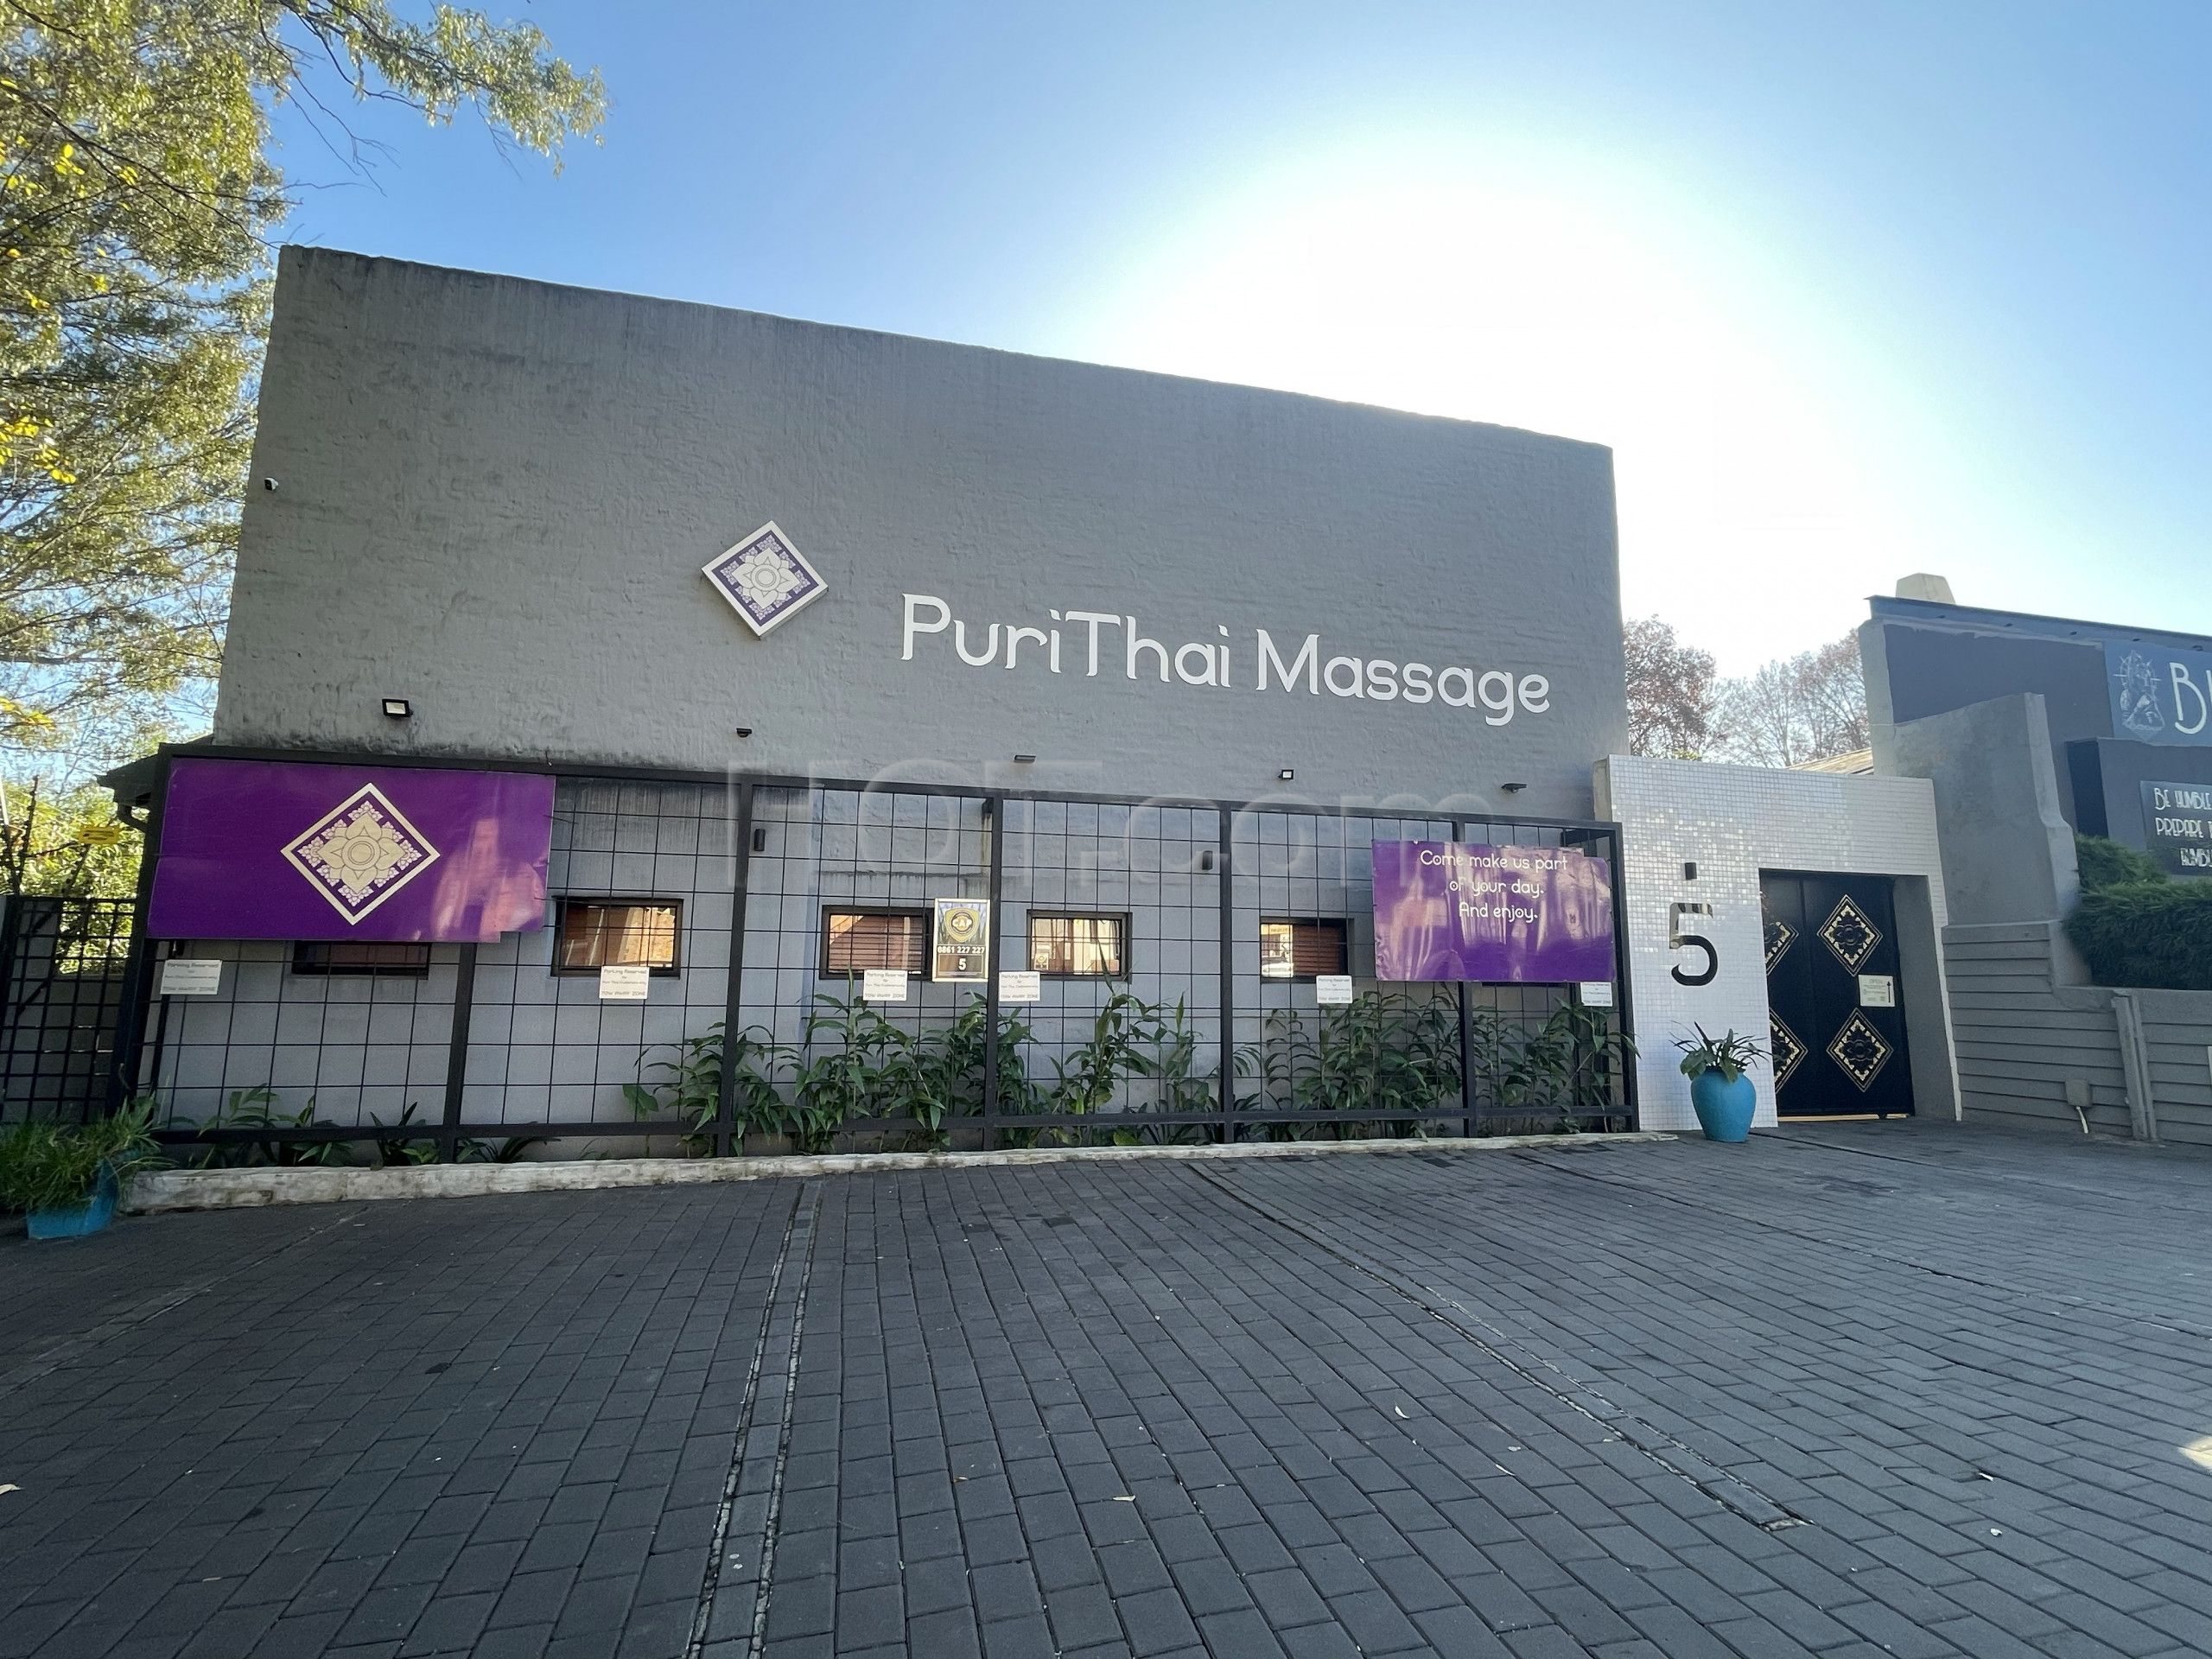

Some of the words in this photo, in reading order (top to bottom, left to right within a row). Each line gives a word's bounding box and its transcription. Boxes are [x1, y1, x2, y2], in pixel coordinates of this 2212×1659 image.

[901, 593, 1231, 689] PuriThai
[1255, 627, 1550, 726] Massage
[2154, 787, 2171, 810] BE
[2155, 817, 2204, 838] PREPARE
[1420, 850, 1464, 866] Come
[1470, 854, 1508, 868] make
[1513, 858, 1530, 869] us
[1535, 855, 1568, 874] part
[1449, 876, 1466, 892] of
[1471, 880, 1507, 897] your
[1511, 879, 1545, 899] day.
[1459, 901, 1489, 918] And
[1493, 905, 1539, 923] enjoy.
[957, 945, 970, 954] 227
[1669, 903, 1718, 986] 5
[958, 957, 967, 971] 5
